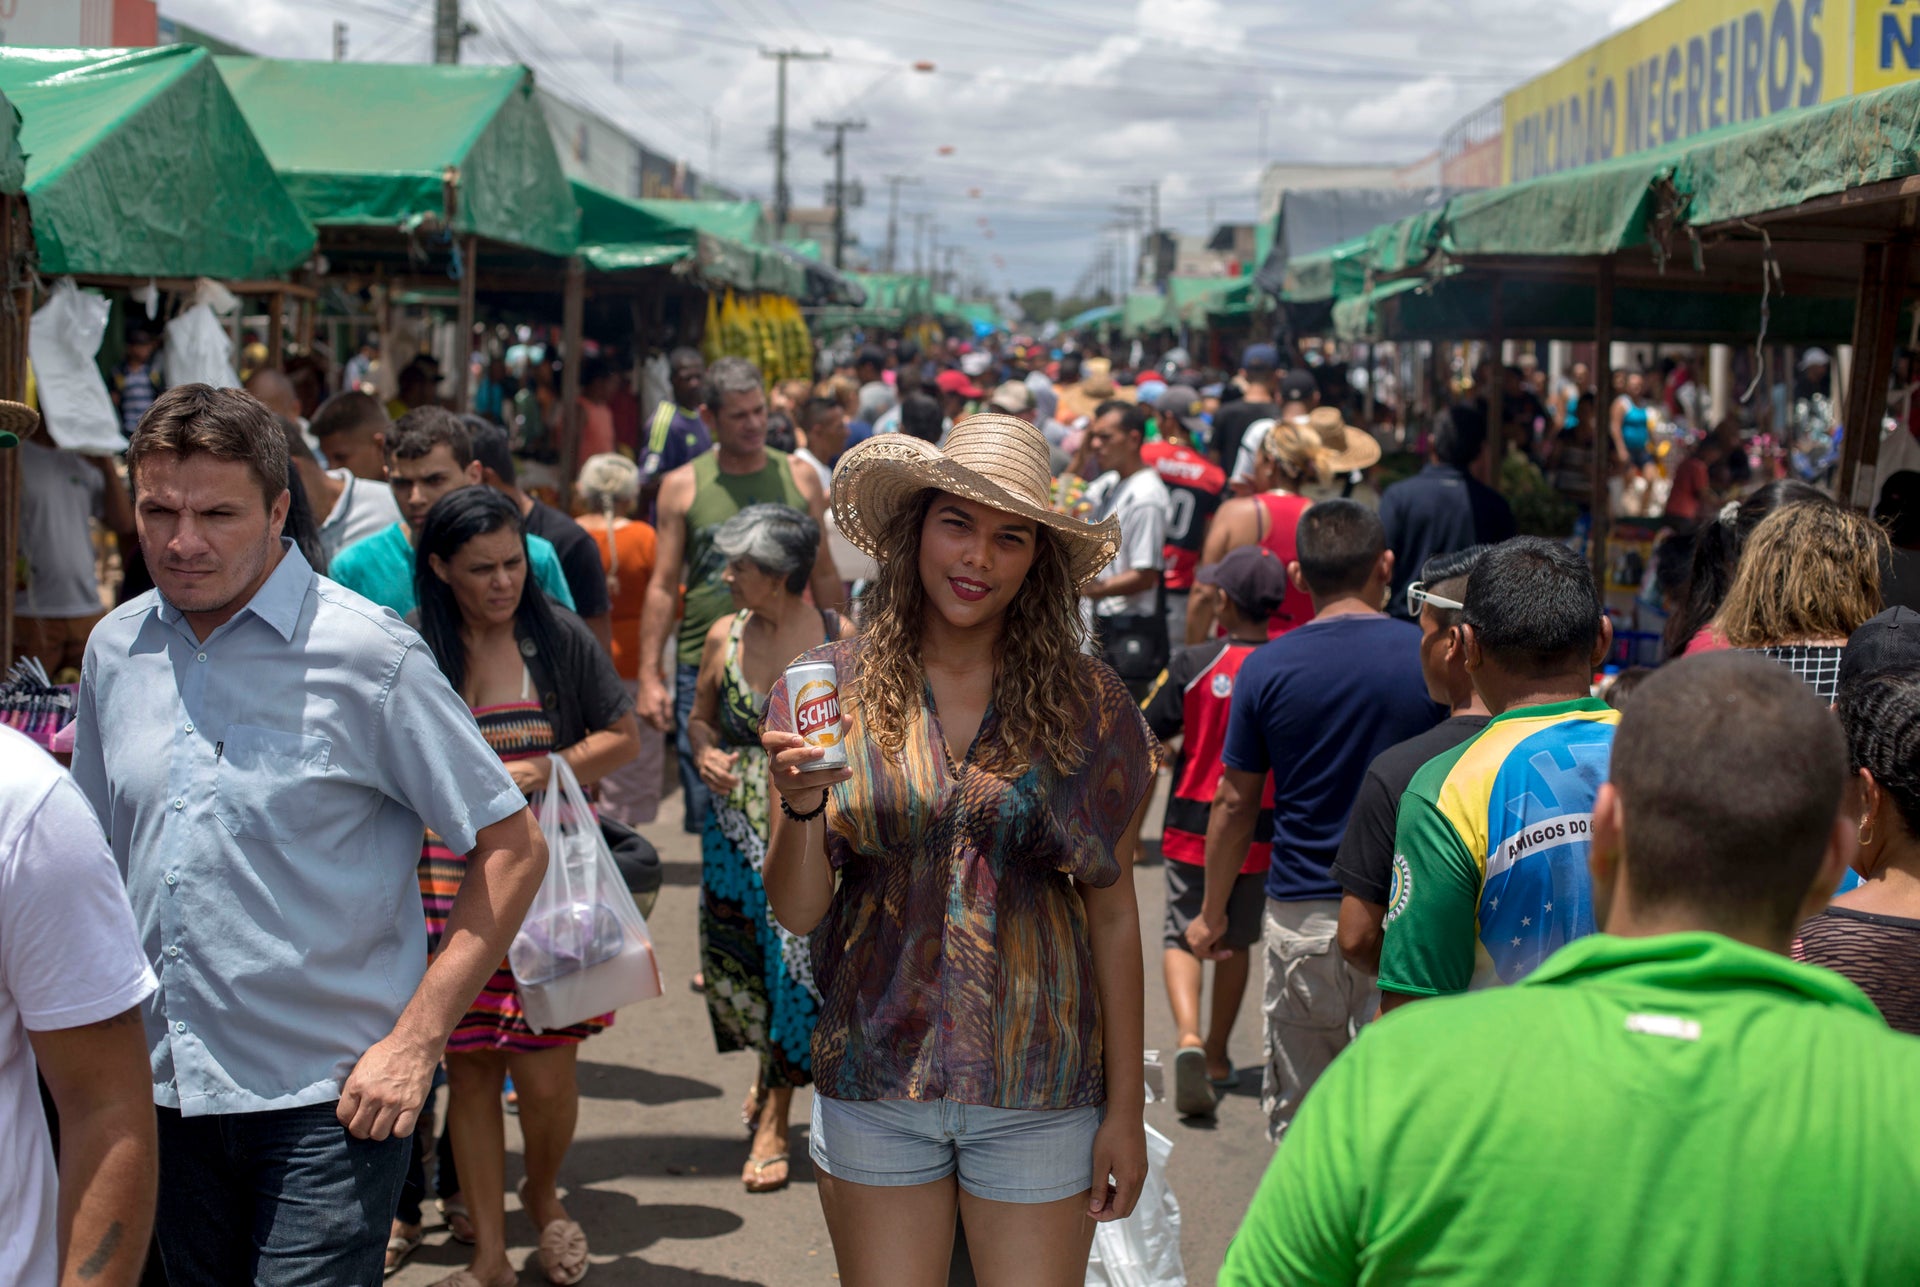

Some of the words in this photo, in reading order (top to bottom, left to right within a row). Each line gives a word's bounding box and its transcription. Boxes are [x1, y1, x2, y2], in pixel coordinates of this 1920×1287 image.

[1627, 0, 1823, 156] NEGREIROS
[799, 696, 840, 731] SCHIN
[1508, 823, 1566, 859] AMIGOS
[1569, 820, 1587, 834] DO
